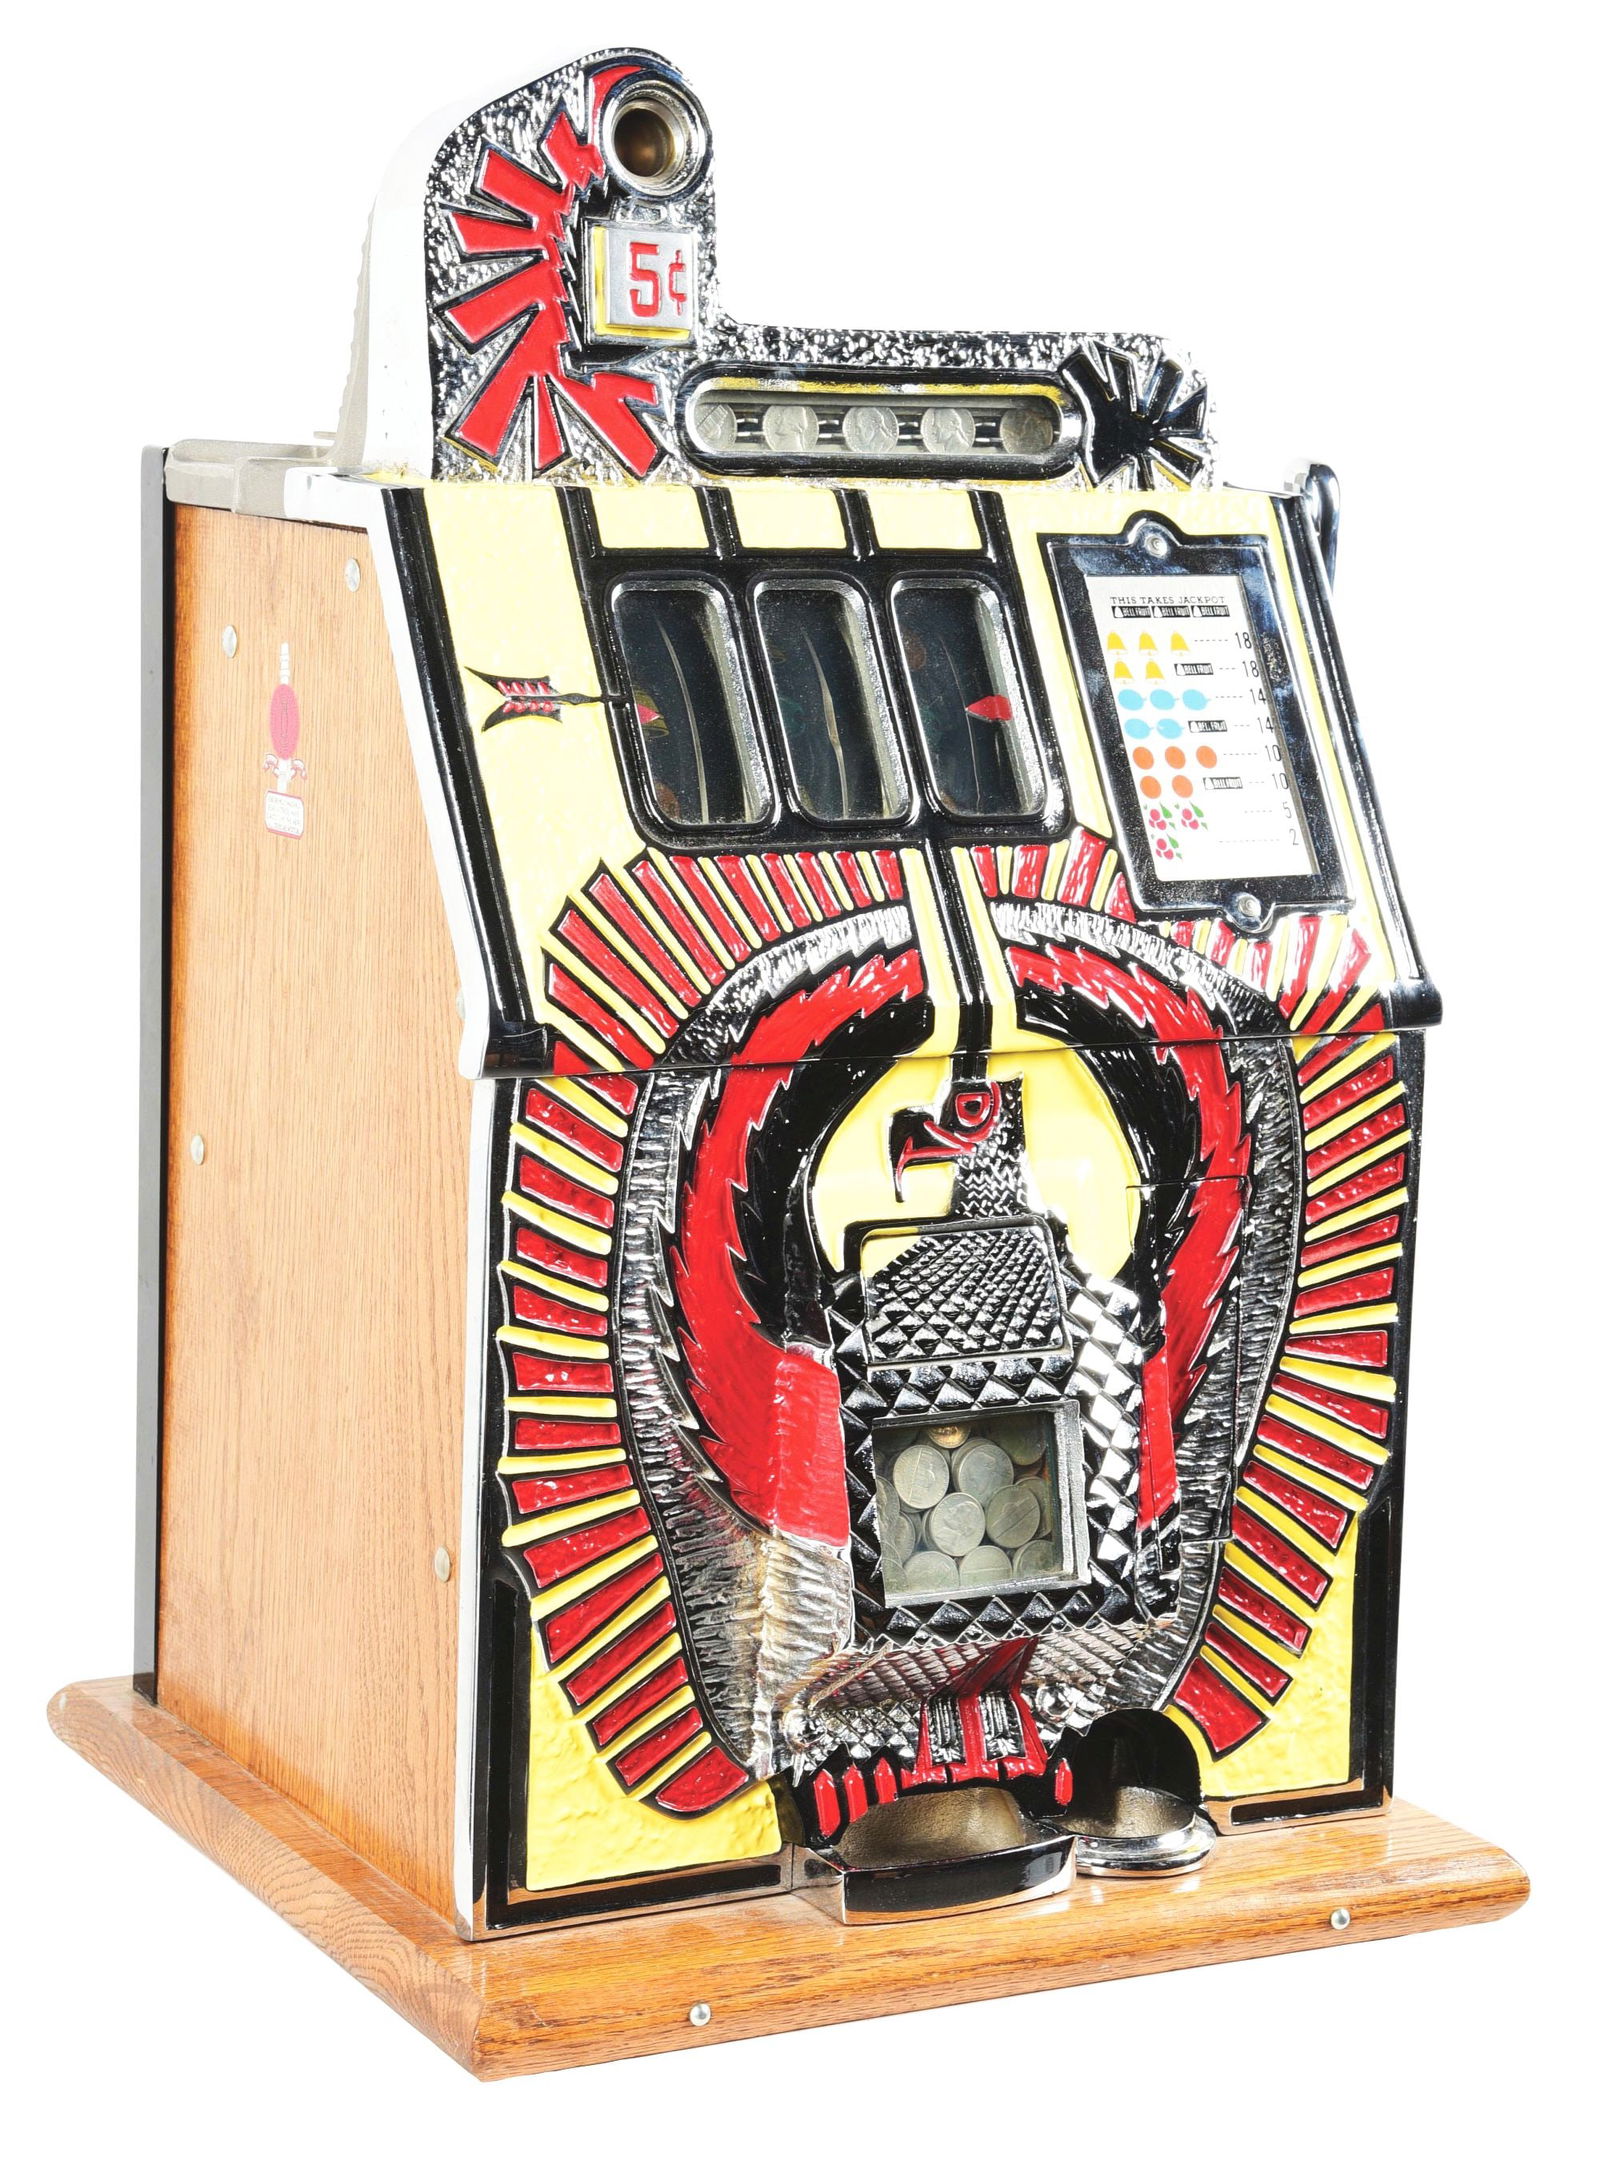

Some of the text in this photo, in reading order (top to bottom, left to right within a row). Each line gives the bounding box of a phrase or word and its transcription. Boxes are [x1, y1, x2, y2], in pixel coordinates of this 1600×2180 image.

[629, 242, 687, 318] 5¢
[1110, 596, 1225, 605] THIS TAKES JACKPOT
[1122, 606, 1230, 617] BELL FRUIT BELL FRUIT BELL FRUIT
[1235, 632, 1252, 649] 18
[1242, 660, 1260, 678] 18
[1250, 688, 1267, 705] 14
[1257, 717, 1274, 734] 14
[1265, 745, 1281, 761] 10
[1272, 773, 1289, 790] 10
[1282, 801, 1292, 818] 5
[1289, 829, 1299, 846] 2
